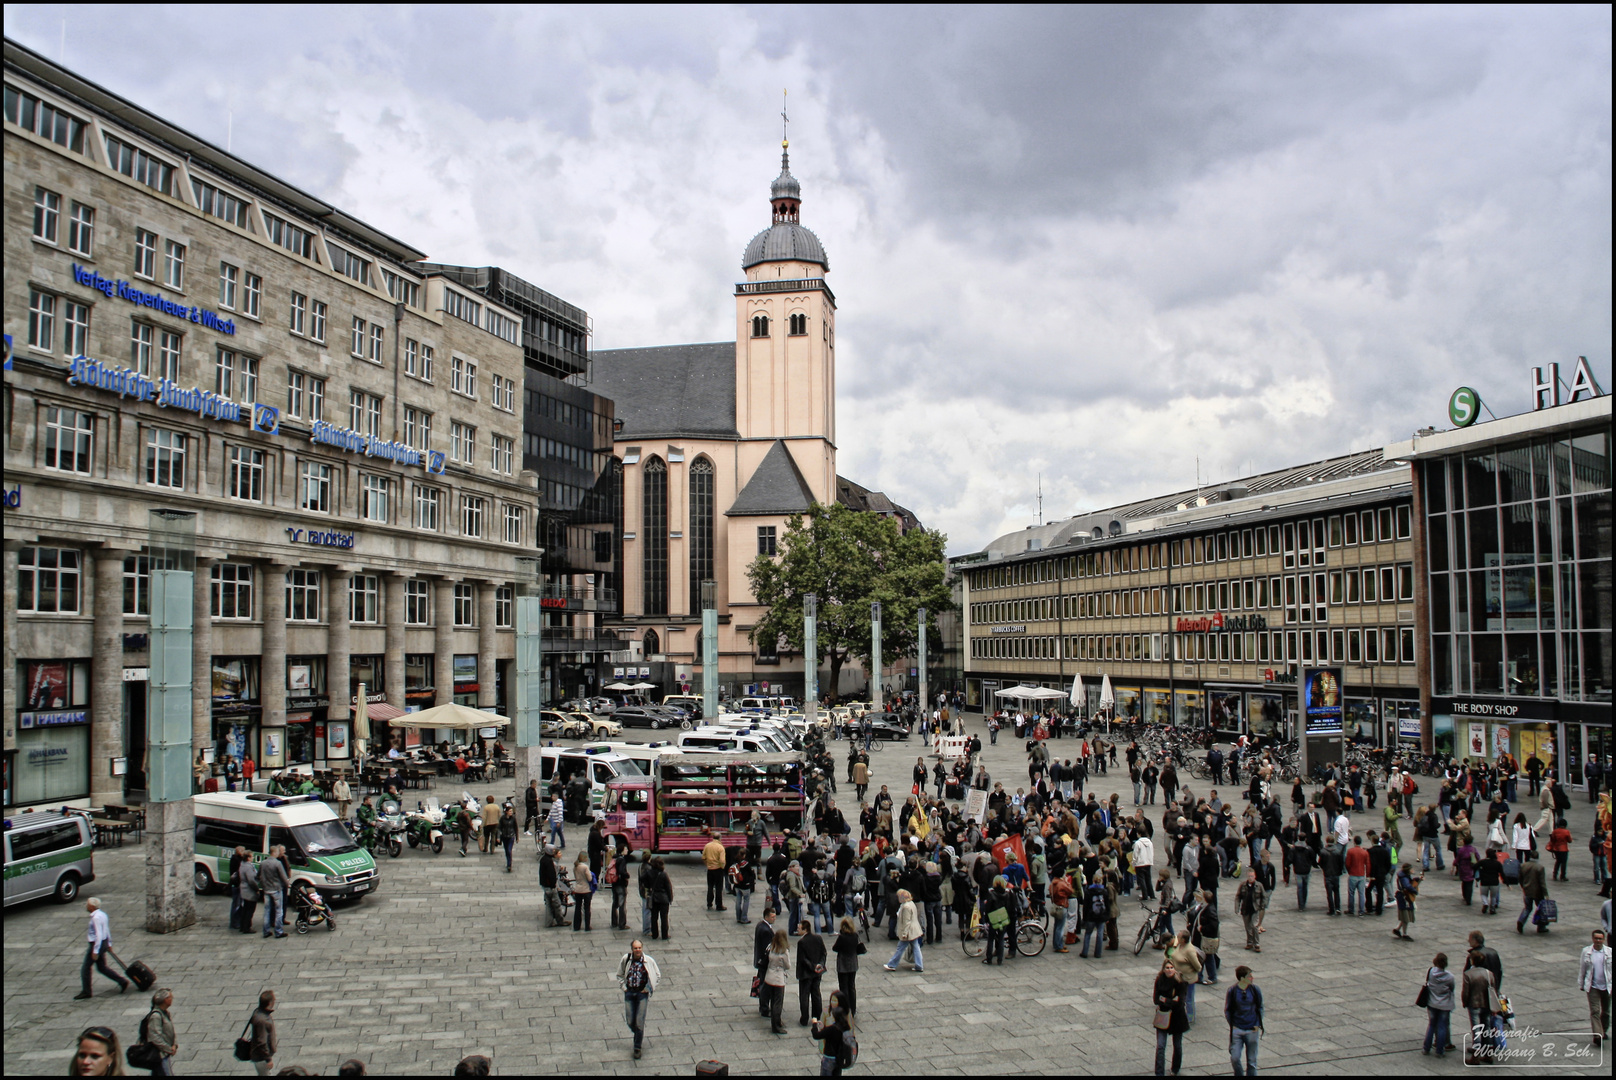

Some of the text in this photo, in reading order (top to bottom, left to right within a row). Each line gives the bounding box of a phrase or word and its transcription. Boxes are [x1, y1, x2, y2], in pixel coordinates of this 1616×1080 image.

[72, 262, 236, 336] Verlag Kiepenheuer & Witsch
[1453, 391, 1472, 422] S
[308, 530, 354, 548] randstad
[1011, 625, 1026, 633] COFFEE
[1453, 703, 1518, 715] THE BODY SHOP
[36, 712, 86, 725] HALKBANK
[1399, 719, 1421, 731] Change
[20, 861, 48, 875] POLIZEI
[340, 856, 366, 867] POLIZEI
